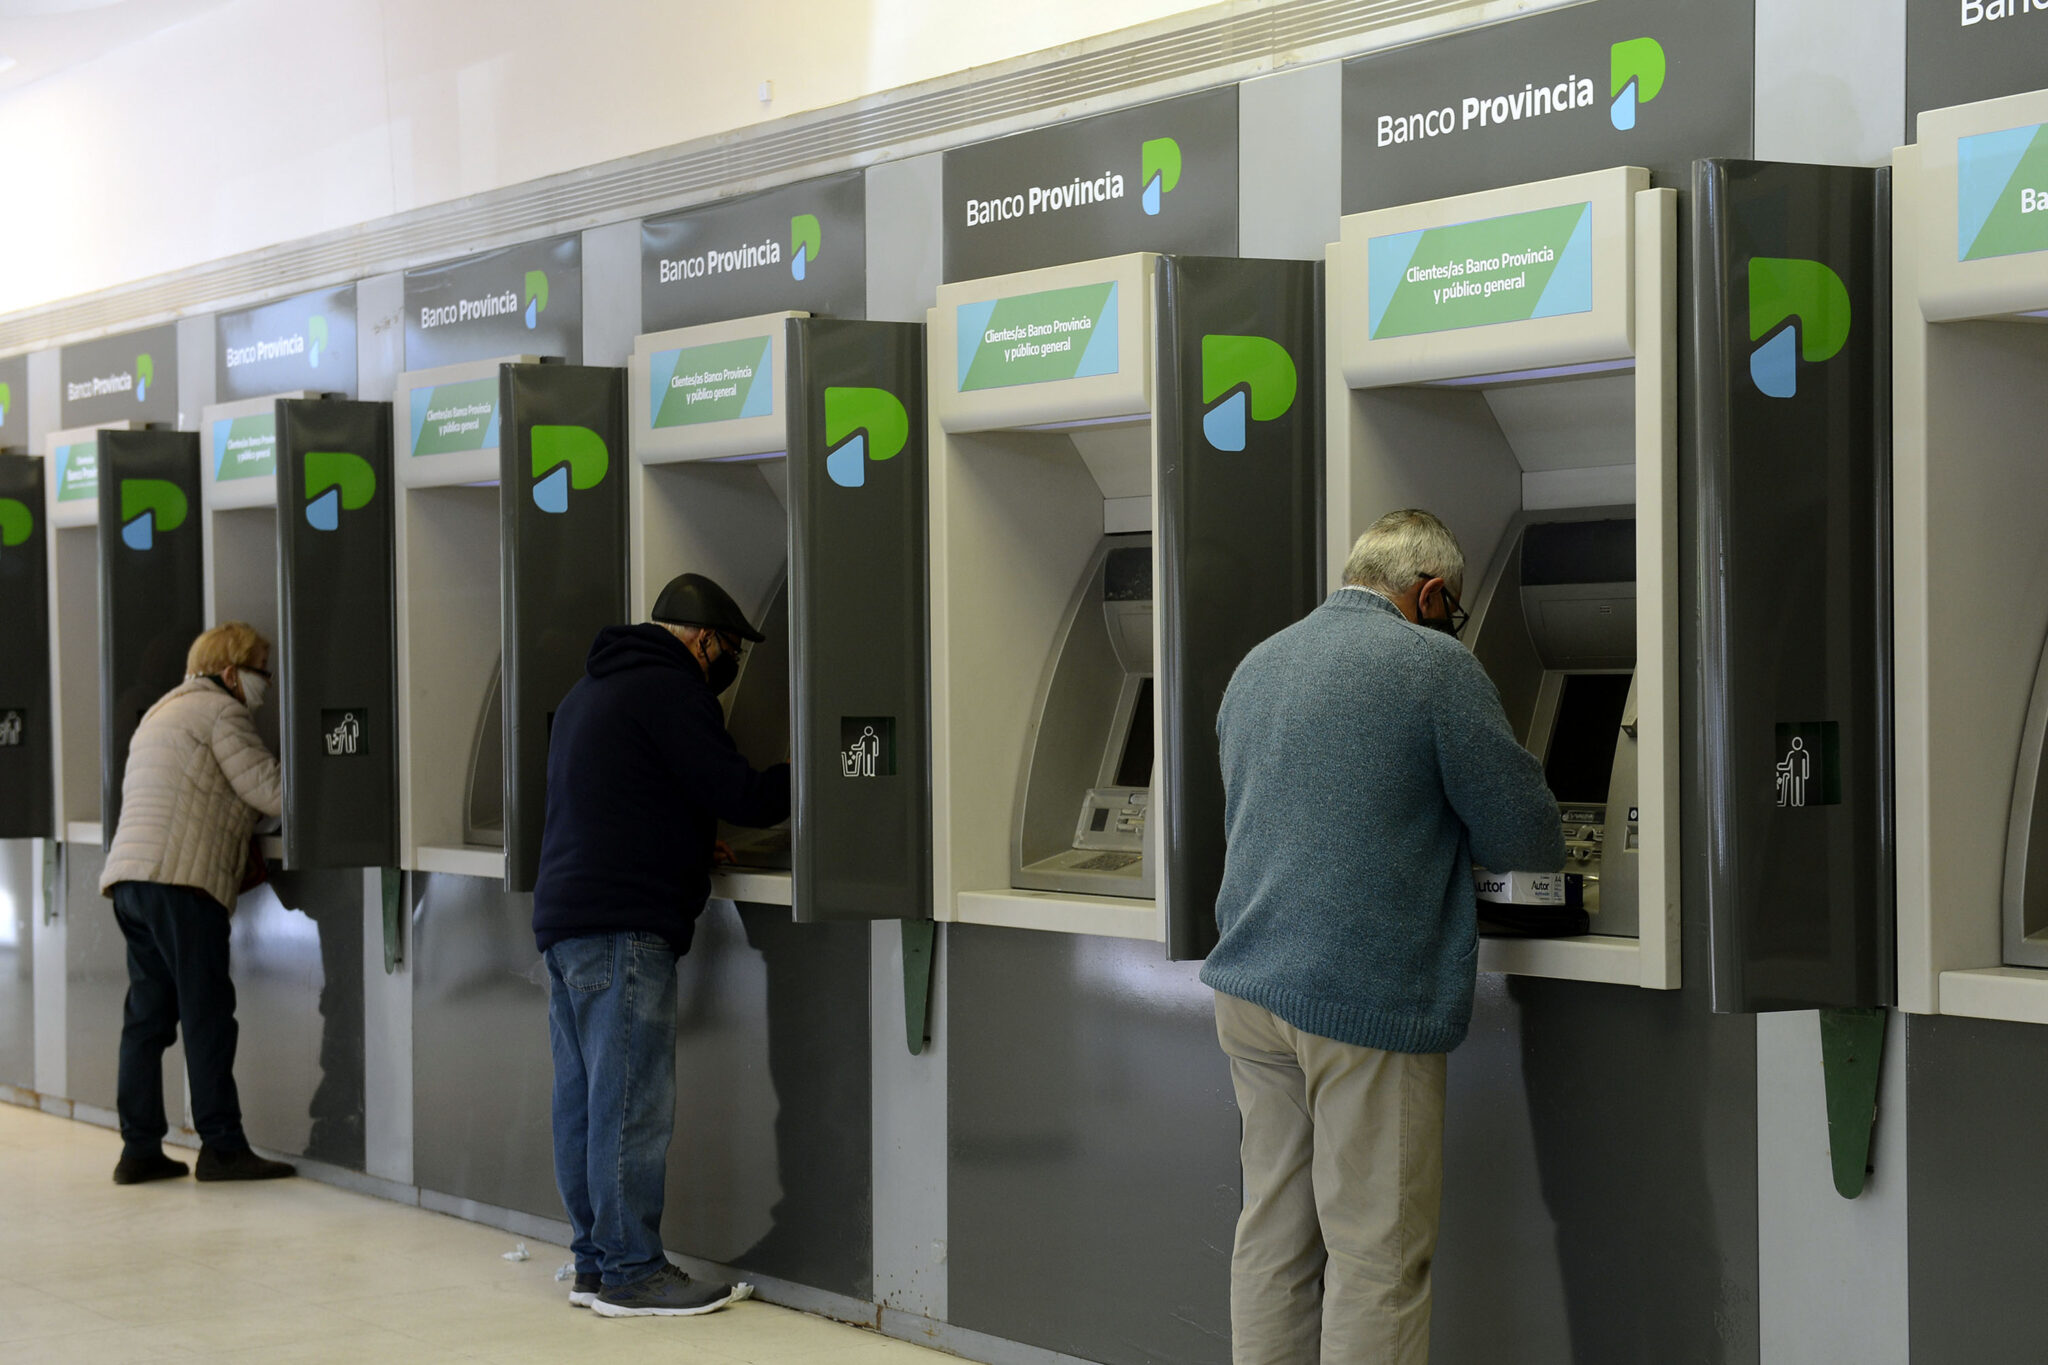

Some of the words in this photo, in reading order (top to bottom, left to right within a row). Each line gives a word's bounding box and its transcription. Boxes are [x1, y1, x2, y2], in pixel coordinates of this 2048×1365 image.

[1377, 107, 1455, 148] Banco
[1461, 74, 1594, 130] Provincia
[967, 194, 1024, 227] Banco
[1028, 171, 1124, 215] Provincia
[660, 256, 705, 283] Banco
[707, 239, 781, 275] Provincia
[1406, 259, 1464, 283] Clientes/as
[1466, 256, 1500, 274] Banco
[1501, 245, 1554, 269] Provincia
[1433, 288, 1441, 304] y
[1442, 279, 1482, 303] público
[1484, 272, 1526, 298] general
[421, 305, 457, 329] Banco
[459, 290, 518, 322] Provincia
[985, 325, 1027, 344] Clientes/as
[1027, 323, 1053, 338] Banco
[1053, 315, 1092, 333] Provincia
[226, 344, 256, 368] Banco
[256, 333, 305, 362] Provincia
[1004, 350, 1011, 363] y
[1011, 341, 1040, 362] público
[1040, 336, 1071, 358] general
[704, 371, 722, 384] Banco
[723, 365, 753, 380] Provincia
[691, 387, 714, 404] público
[714, 383, 737, 401] general
[1531, 880, 1550, 891] Autor
